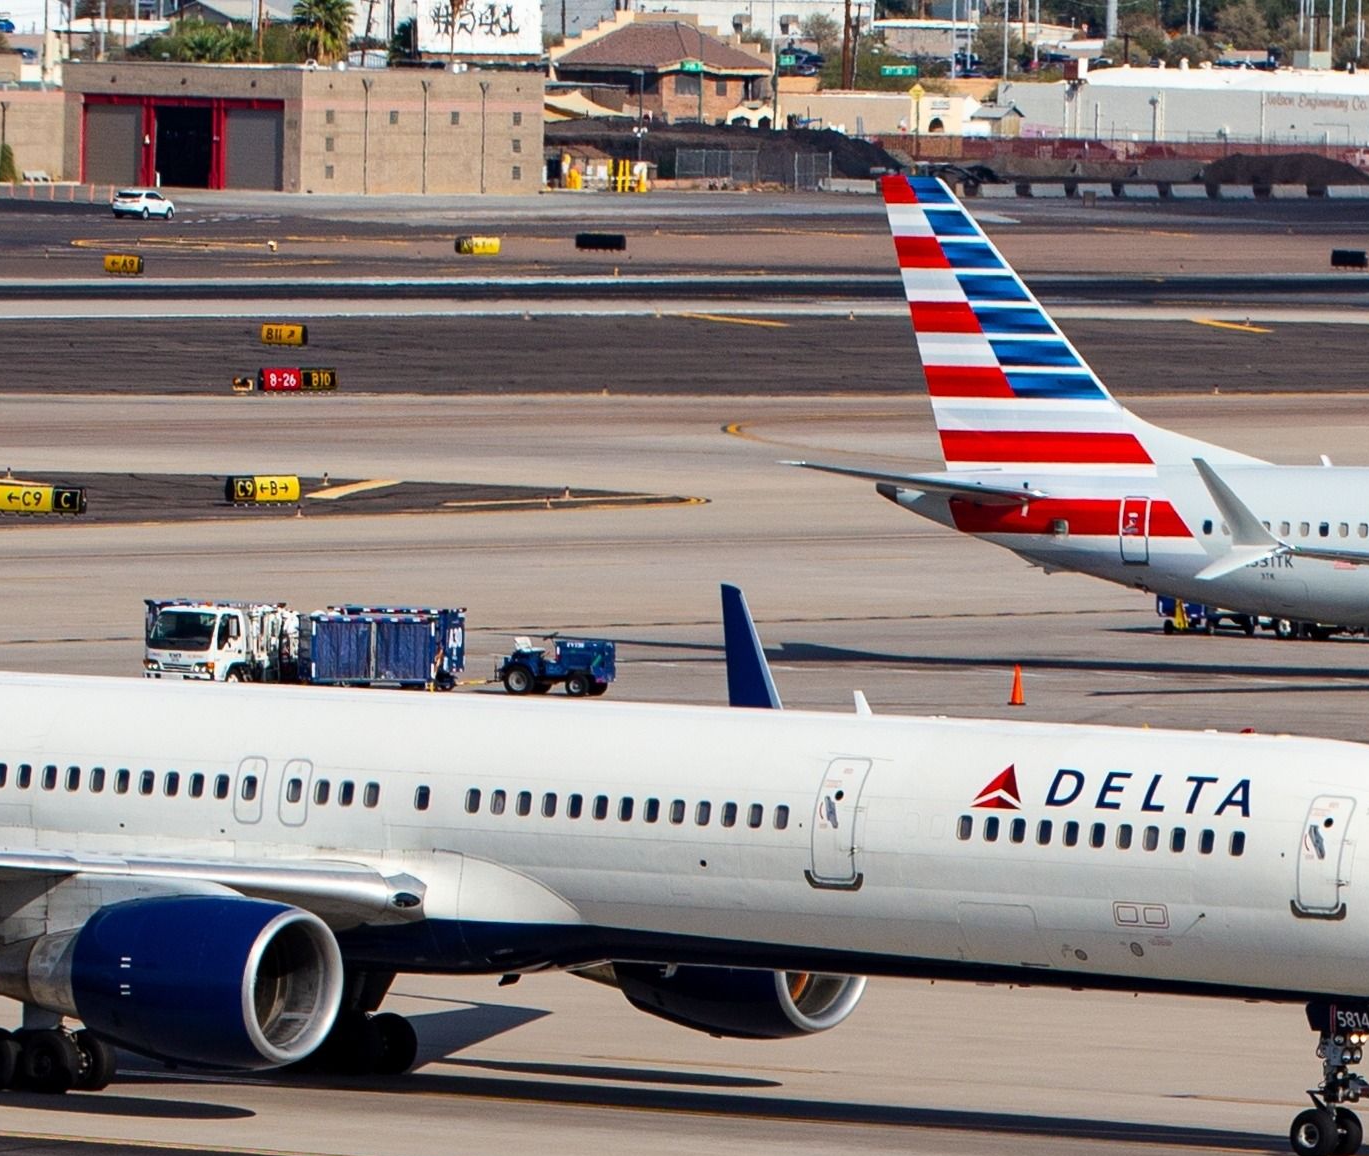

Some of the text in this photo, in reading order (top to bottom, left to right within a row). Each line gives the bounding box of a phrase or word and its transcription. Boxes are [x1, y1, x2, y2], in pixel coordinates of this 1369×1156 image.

[269, 372, 297, 387] 8-26
[237, 480, 278, 497] C9 B
[22, 490, 71, 508] C9 C
[1044, 768, 1252, 818] DELTA
